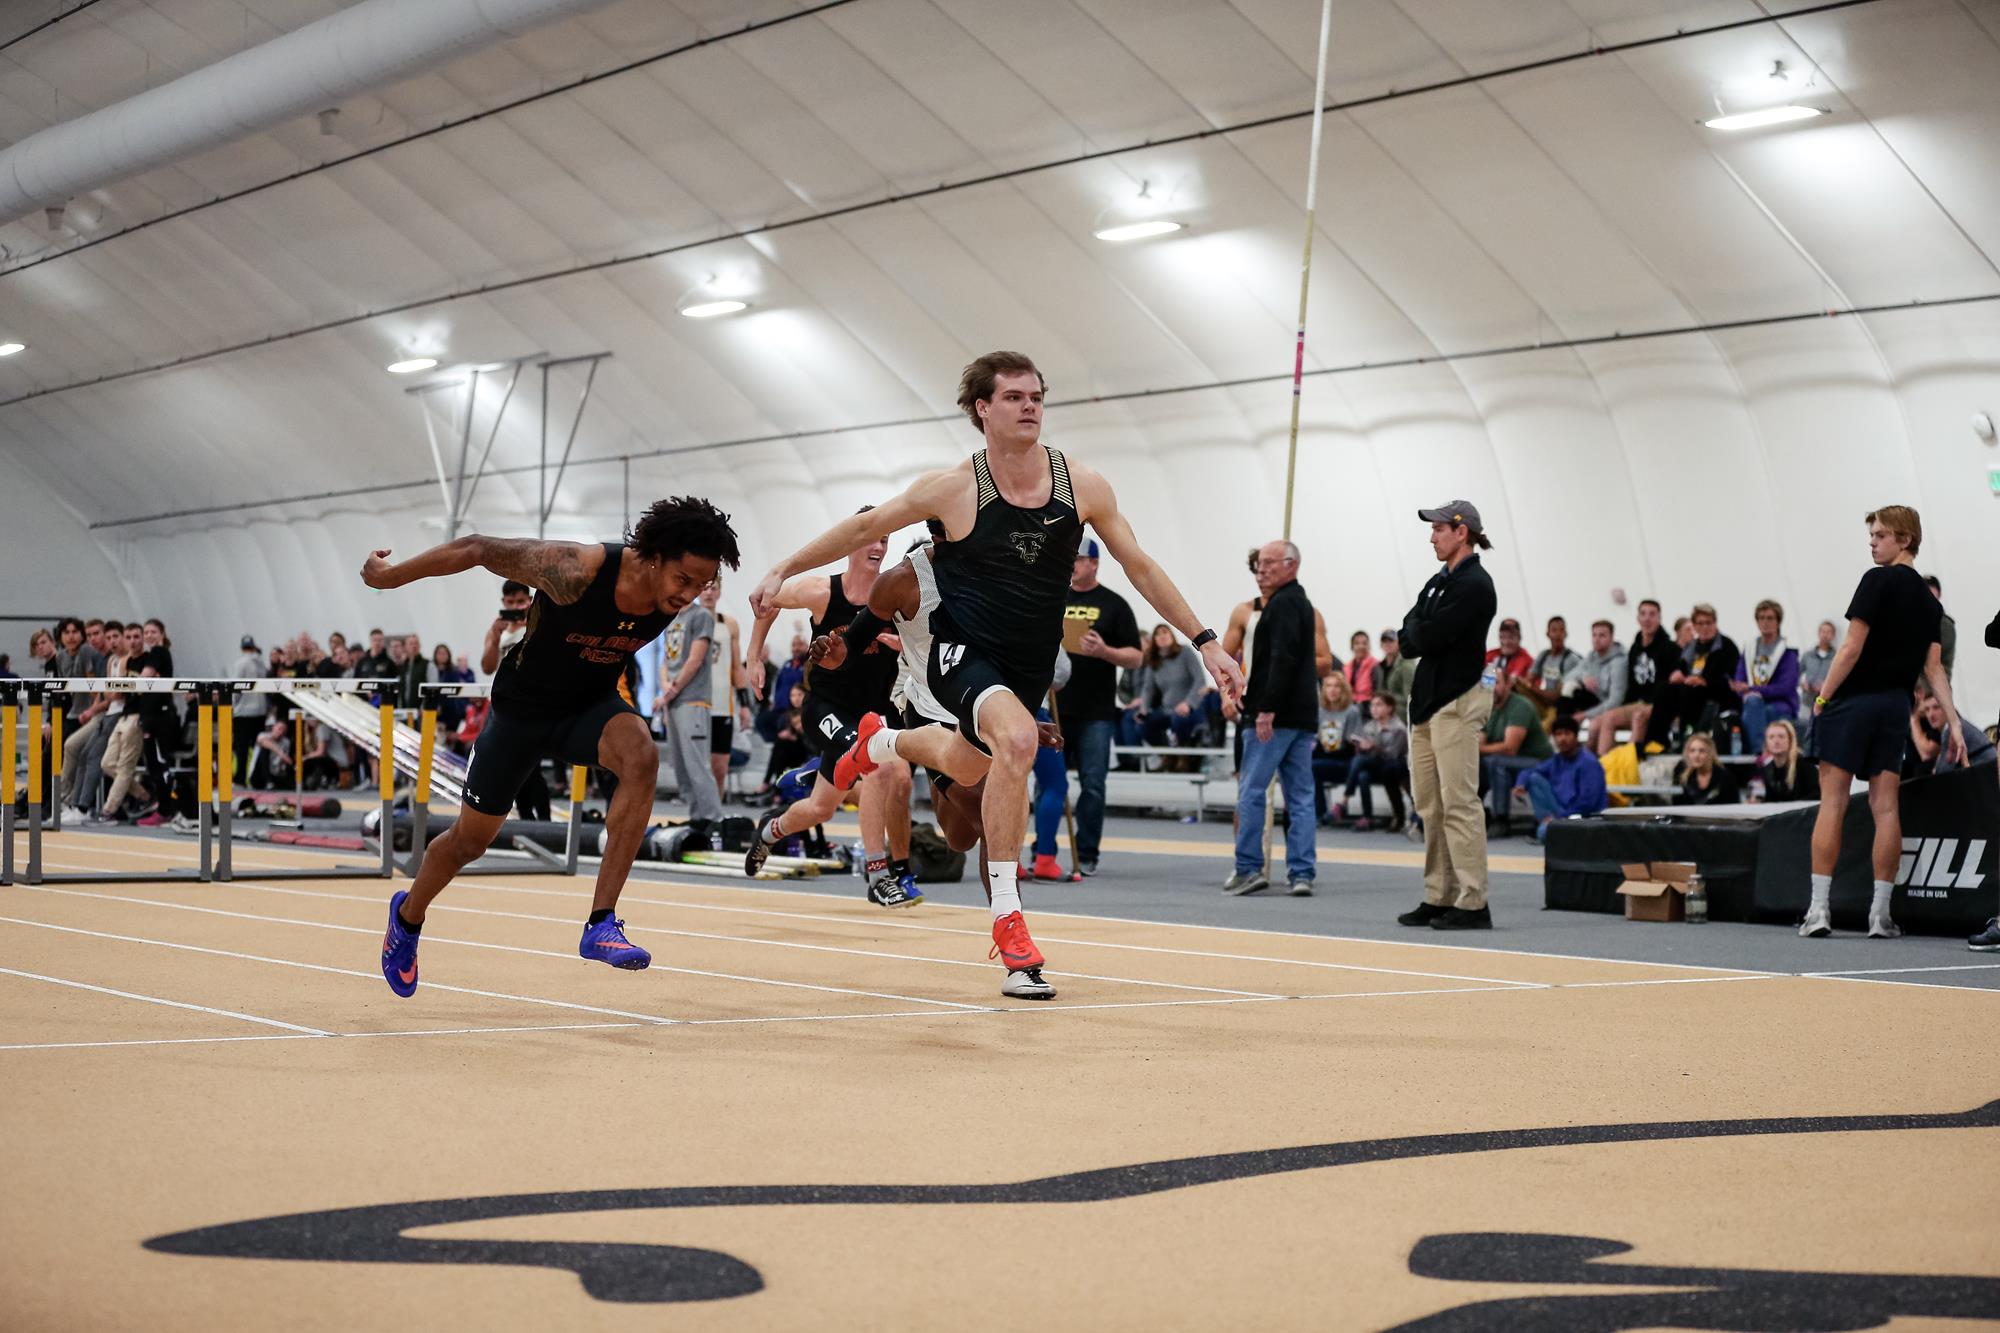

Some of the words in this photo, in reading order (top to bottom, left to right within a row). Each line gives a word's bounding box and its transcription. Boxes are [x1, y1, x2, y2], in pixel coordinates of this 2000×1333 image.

[1064, 606, 1099, 620] CCS
[822, 717, 839, 735] 2
[1907, 889, 1925, 898] MADE
[1926, 890, 1934, 898] IN
[1934, 890, 1948, 899] USA
